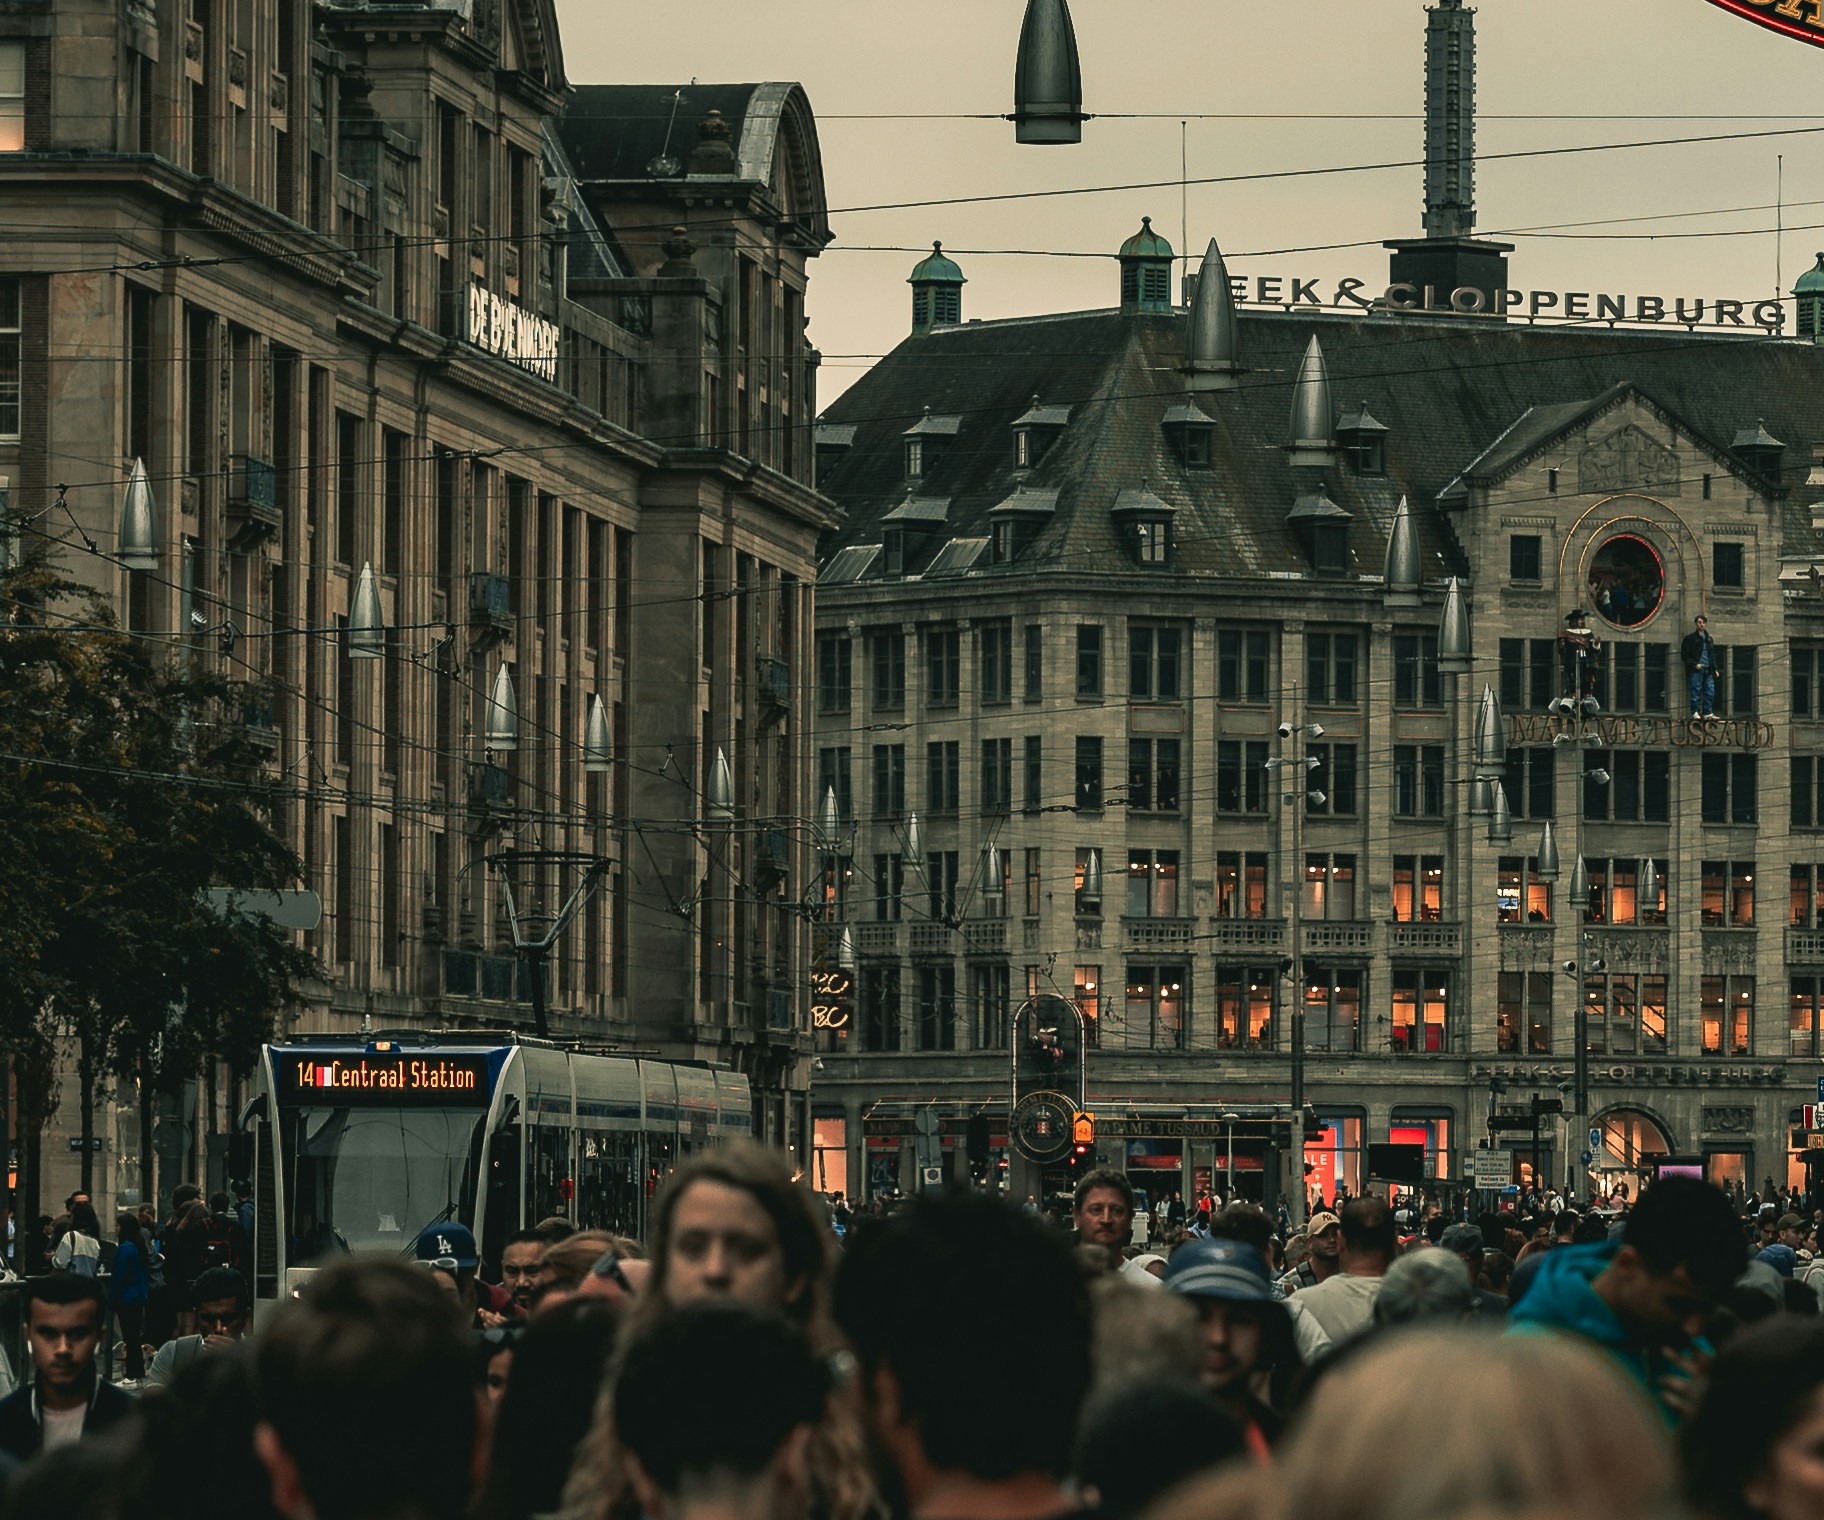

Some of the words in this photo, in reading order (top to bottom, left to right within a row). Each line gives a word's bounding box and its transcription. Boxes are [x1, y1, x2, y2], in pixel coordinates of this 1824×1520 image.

[1335, 278, 1377, 307] &
[1384, 282, 1786, 327] CLOPPENBURG
[1510, 715, 1641, 744] MADAME
[298, 1061, 315, 1088] 14
[332, 1060, 405, 1089] Centraal
[412, 1060, 476, 1089] Station
[1157, 1122, 1221, 1137] TUSSAUD
[437, 1234, 453, 1255] LA
